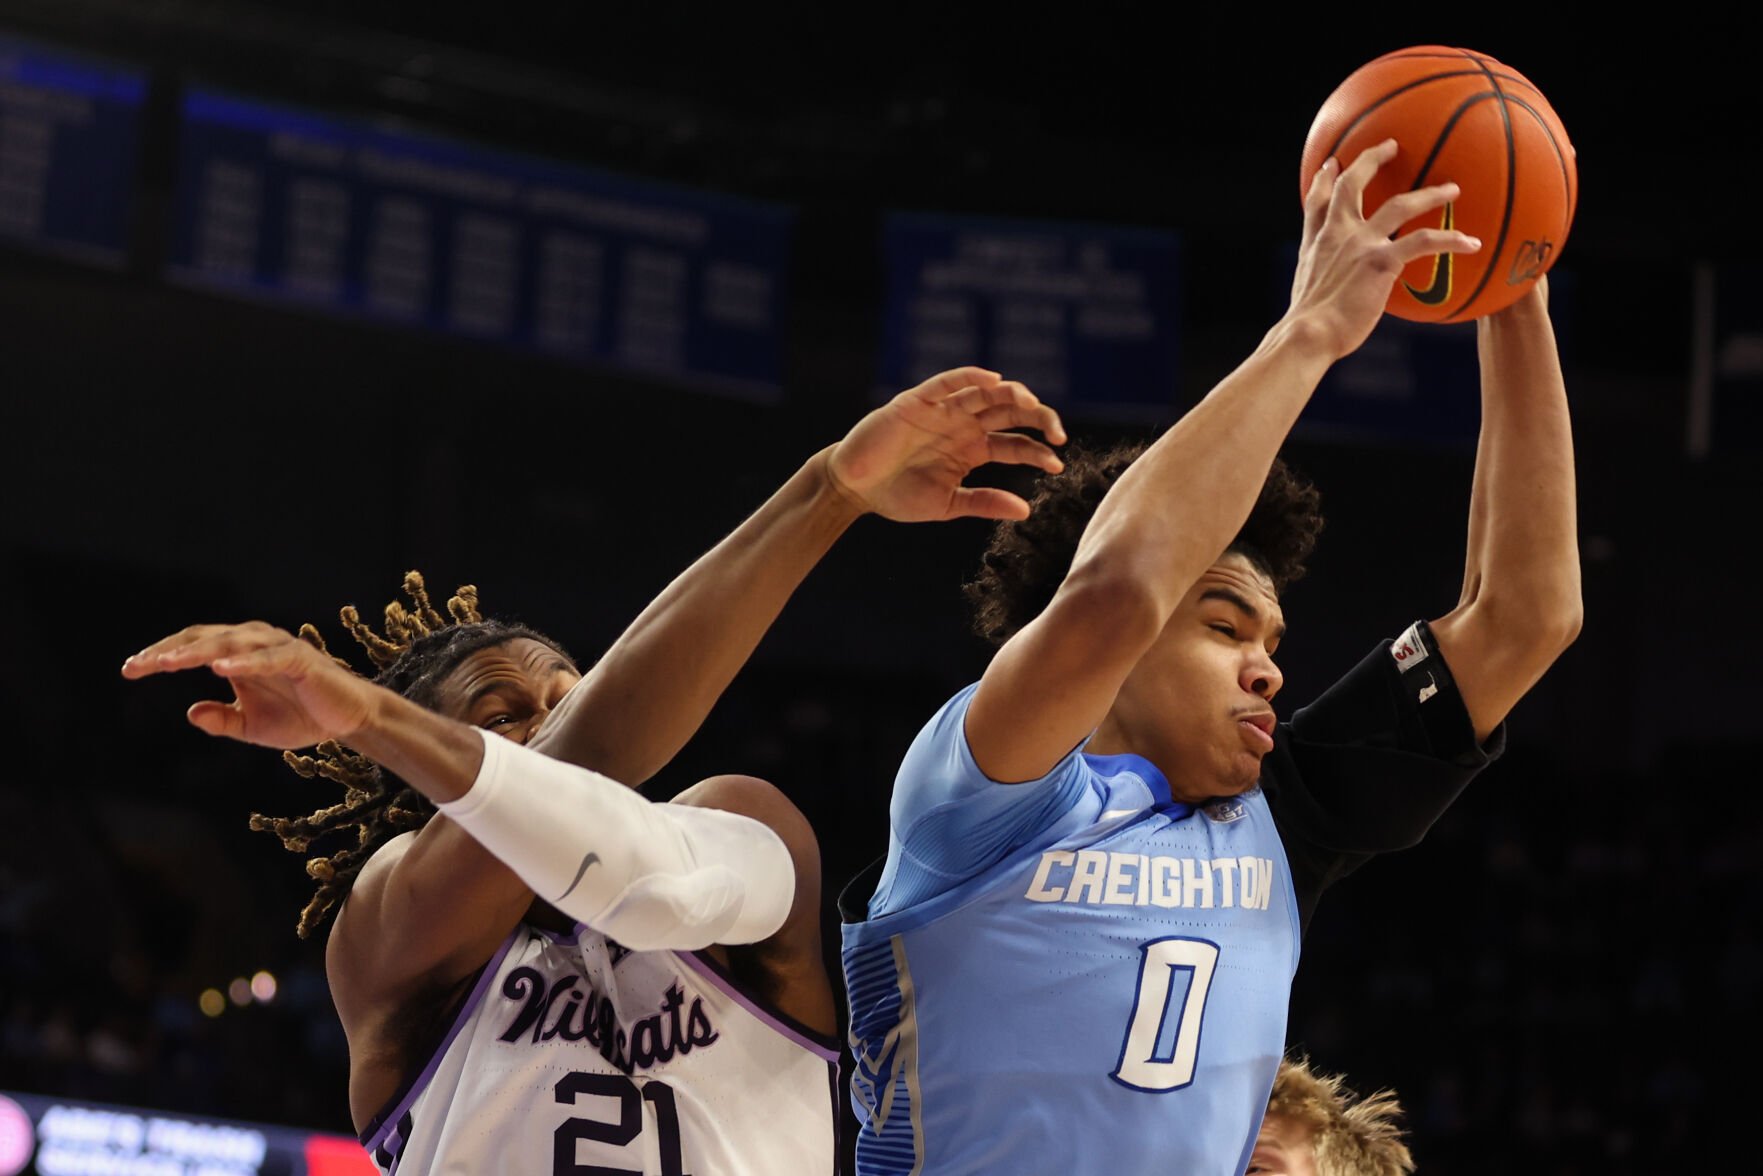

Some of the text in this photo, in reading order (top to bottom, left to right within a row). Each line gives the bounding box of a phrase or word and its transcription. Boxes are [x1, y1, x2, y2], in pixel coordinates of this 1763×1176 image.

[1024, 850, 1273, 912] CREIGHTON
[1108, 936, 1221, 1094] 0
[554, 1071, 691, 1176] 21
